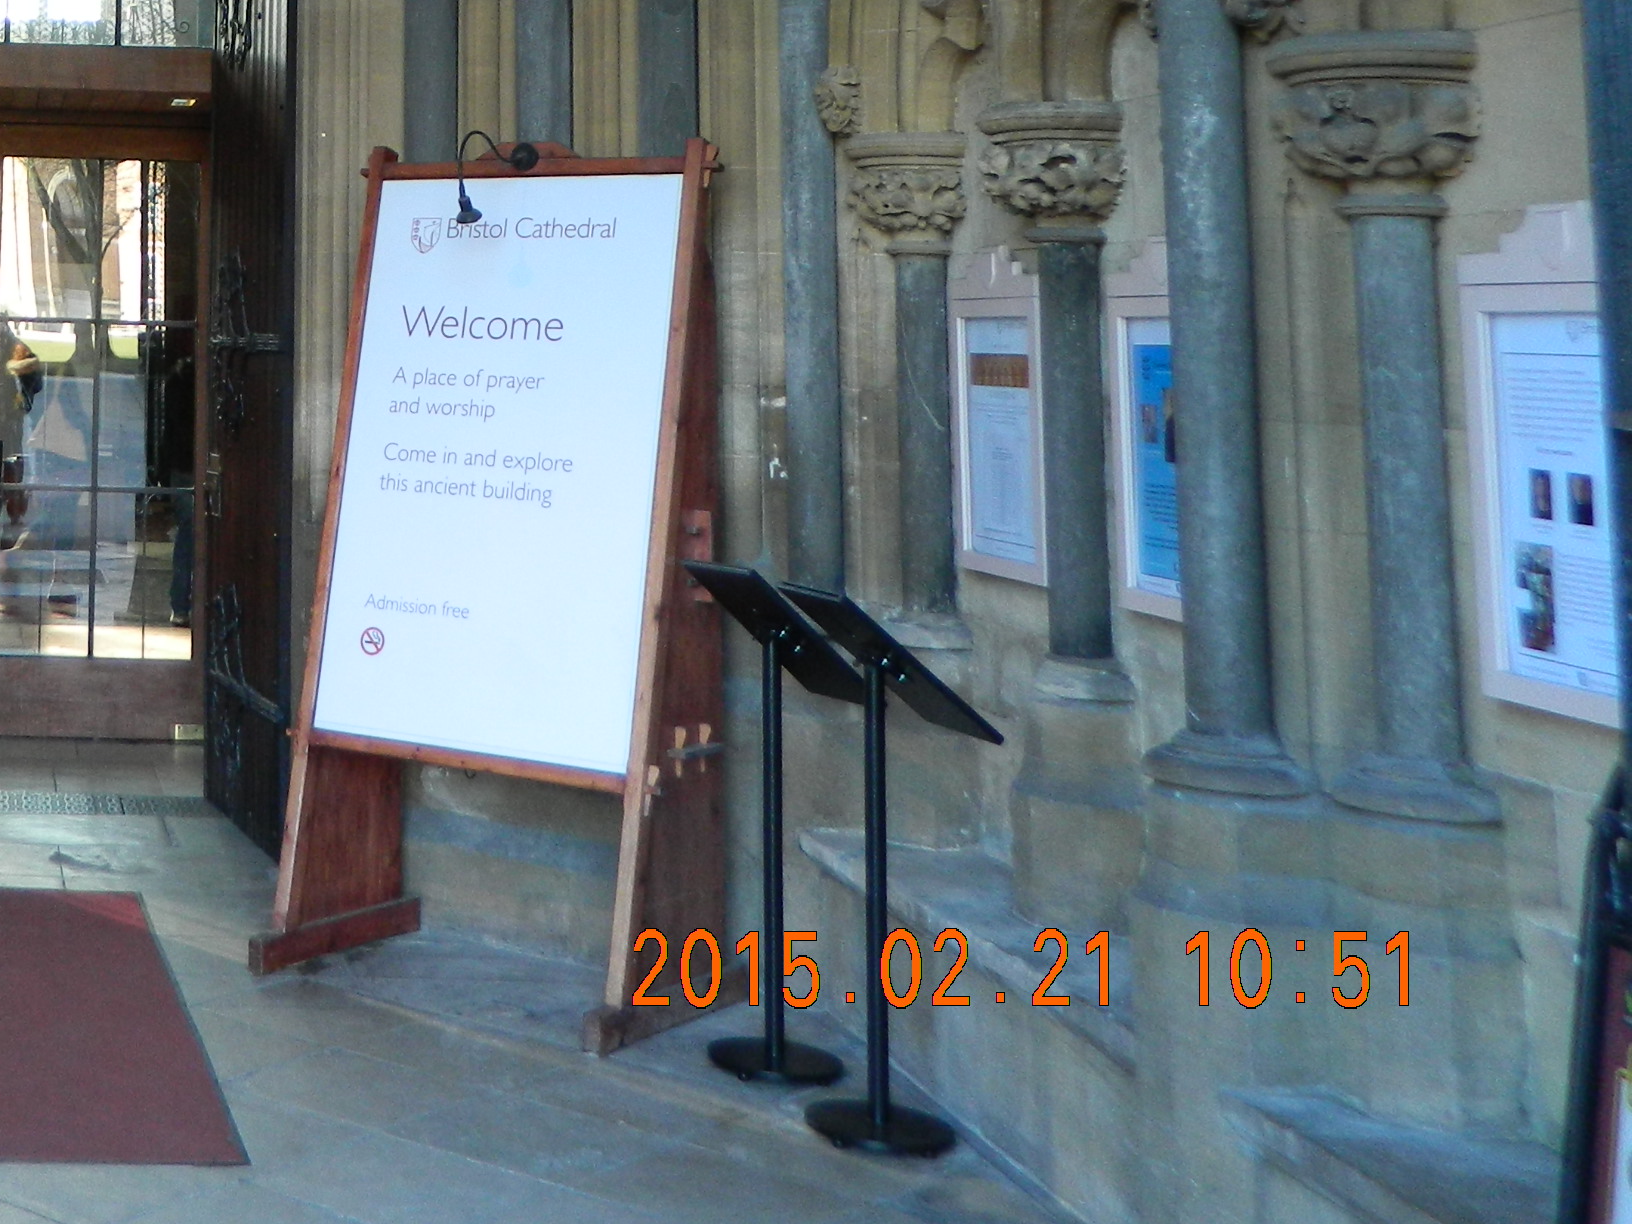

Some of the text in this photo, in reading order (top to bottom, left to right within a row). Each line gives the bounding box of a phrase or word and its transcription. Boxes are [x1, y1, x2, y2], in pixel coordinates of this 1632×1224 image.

[446, 217, 617, 239] Bristol Cathedral
[402, 304, 565, 342] Welcome
[392, 366, 545, 394] A place of prayer
[388, 397, 496, 423] and worship
[383, 442, 574, 476] Come in and explore
[380, 474, 553, 509] this ancient building
[364, 593, 470, 619] Admission free
